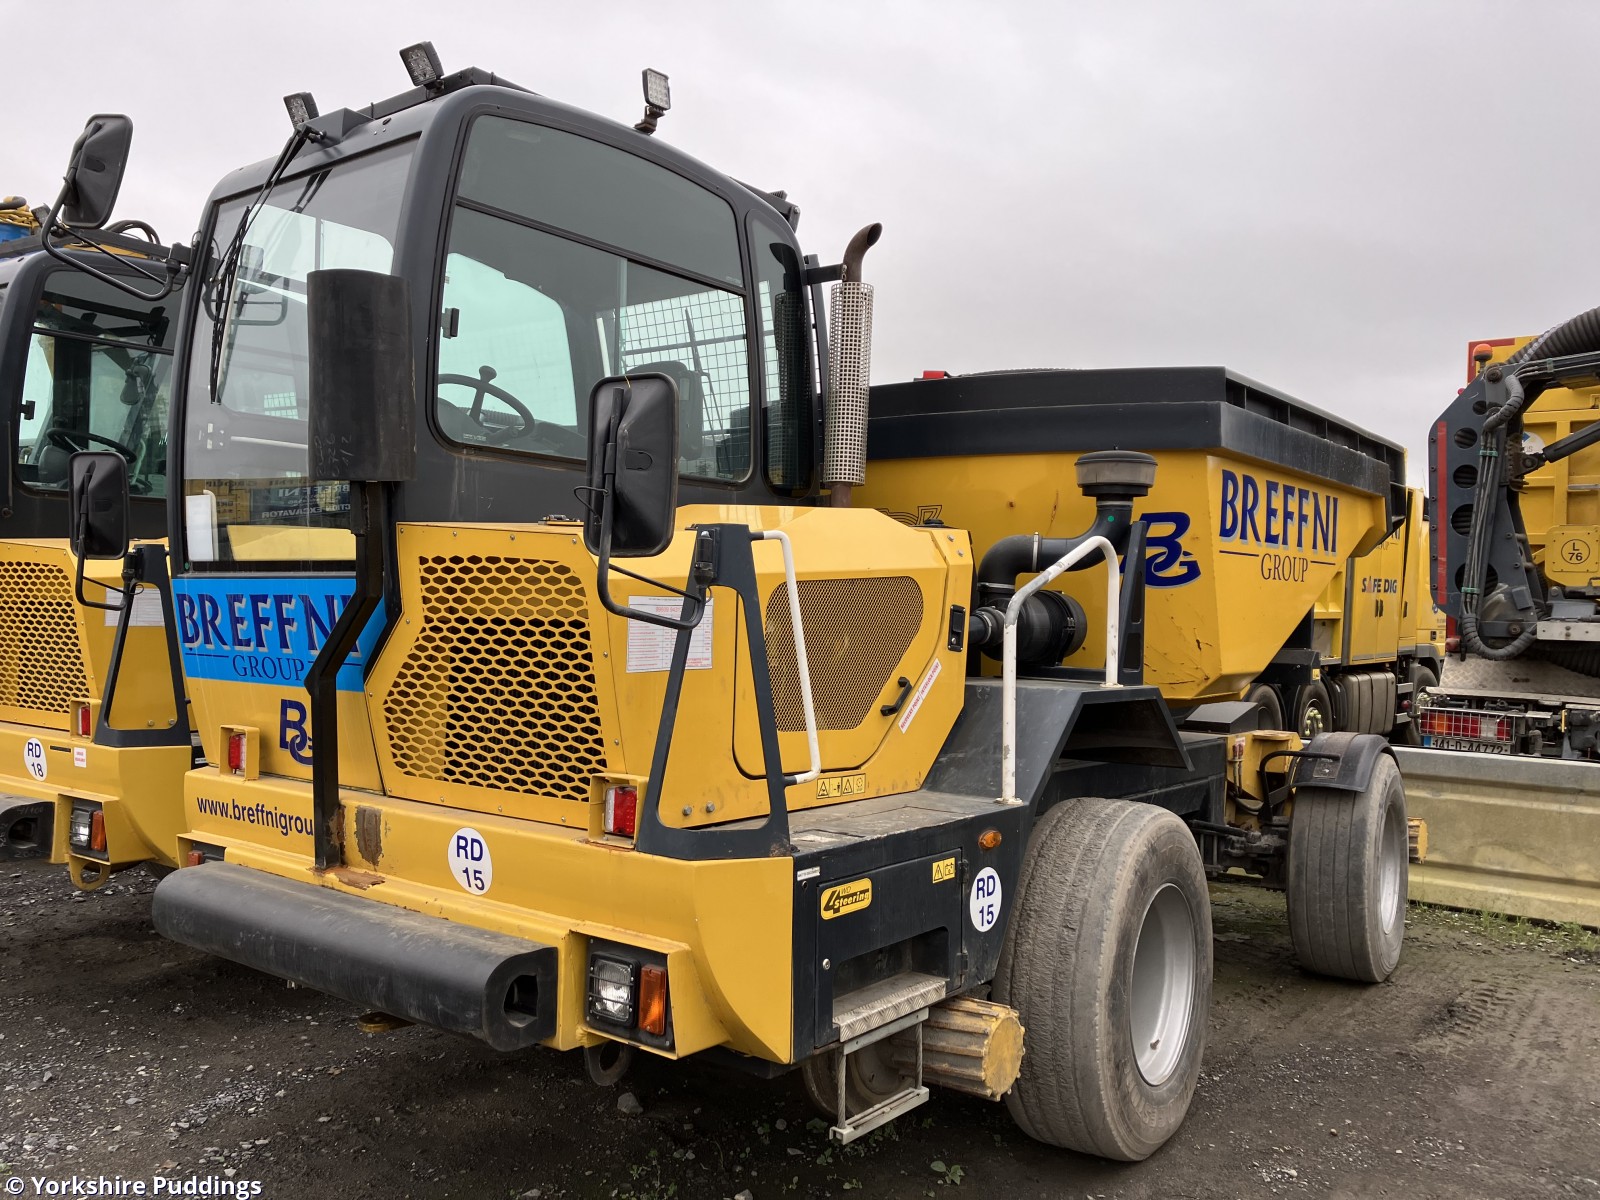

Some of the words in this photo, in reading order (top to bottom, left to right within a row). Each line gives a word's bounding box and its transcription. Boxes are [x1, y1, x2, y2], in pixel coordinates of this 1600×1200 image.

[1219, 469, 1338, 555] BREFFNI
[1568, 552, 1583, 561] 76
[1572, 542, 1580, 552] L
[1261, 553, 1309, 583] GROUP
[1383, 579, 1398, 594] DIG
[232, 654, 305, 681] GROUP
[27, 741, 42, 759] RD
[31, 762, 44, 778] 18
[456, 835, 484, 862] RD
[462, 867, 485, 891] 15
[976, 874, 996, 900] RD
[979, 903, 994, 927] 15
